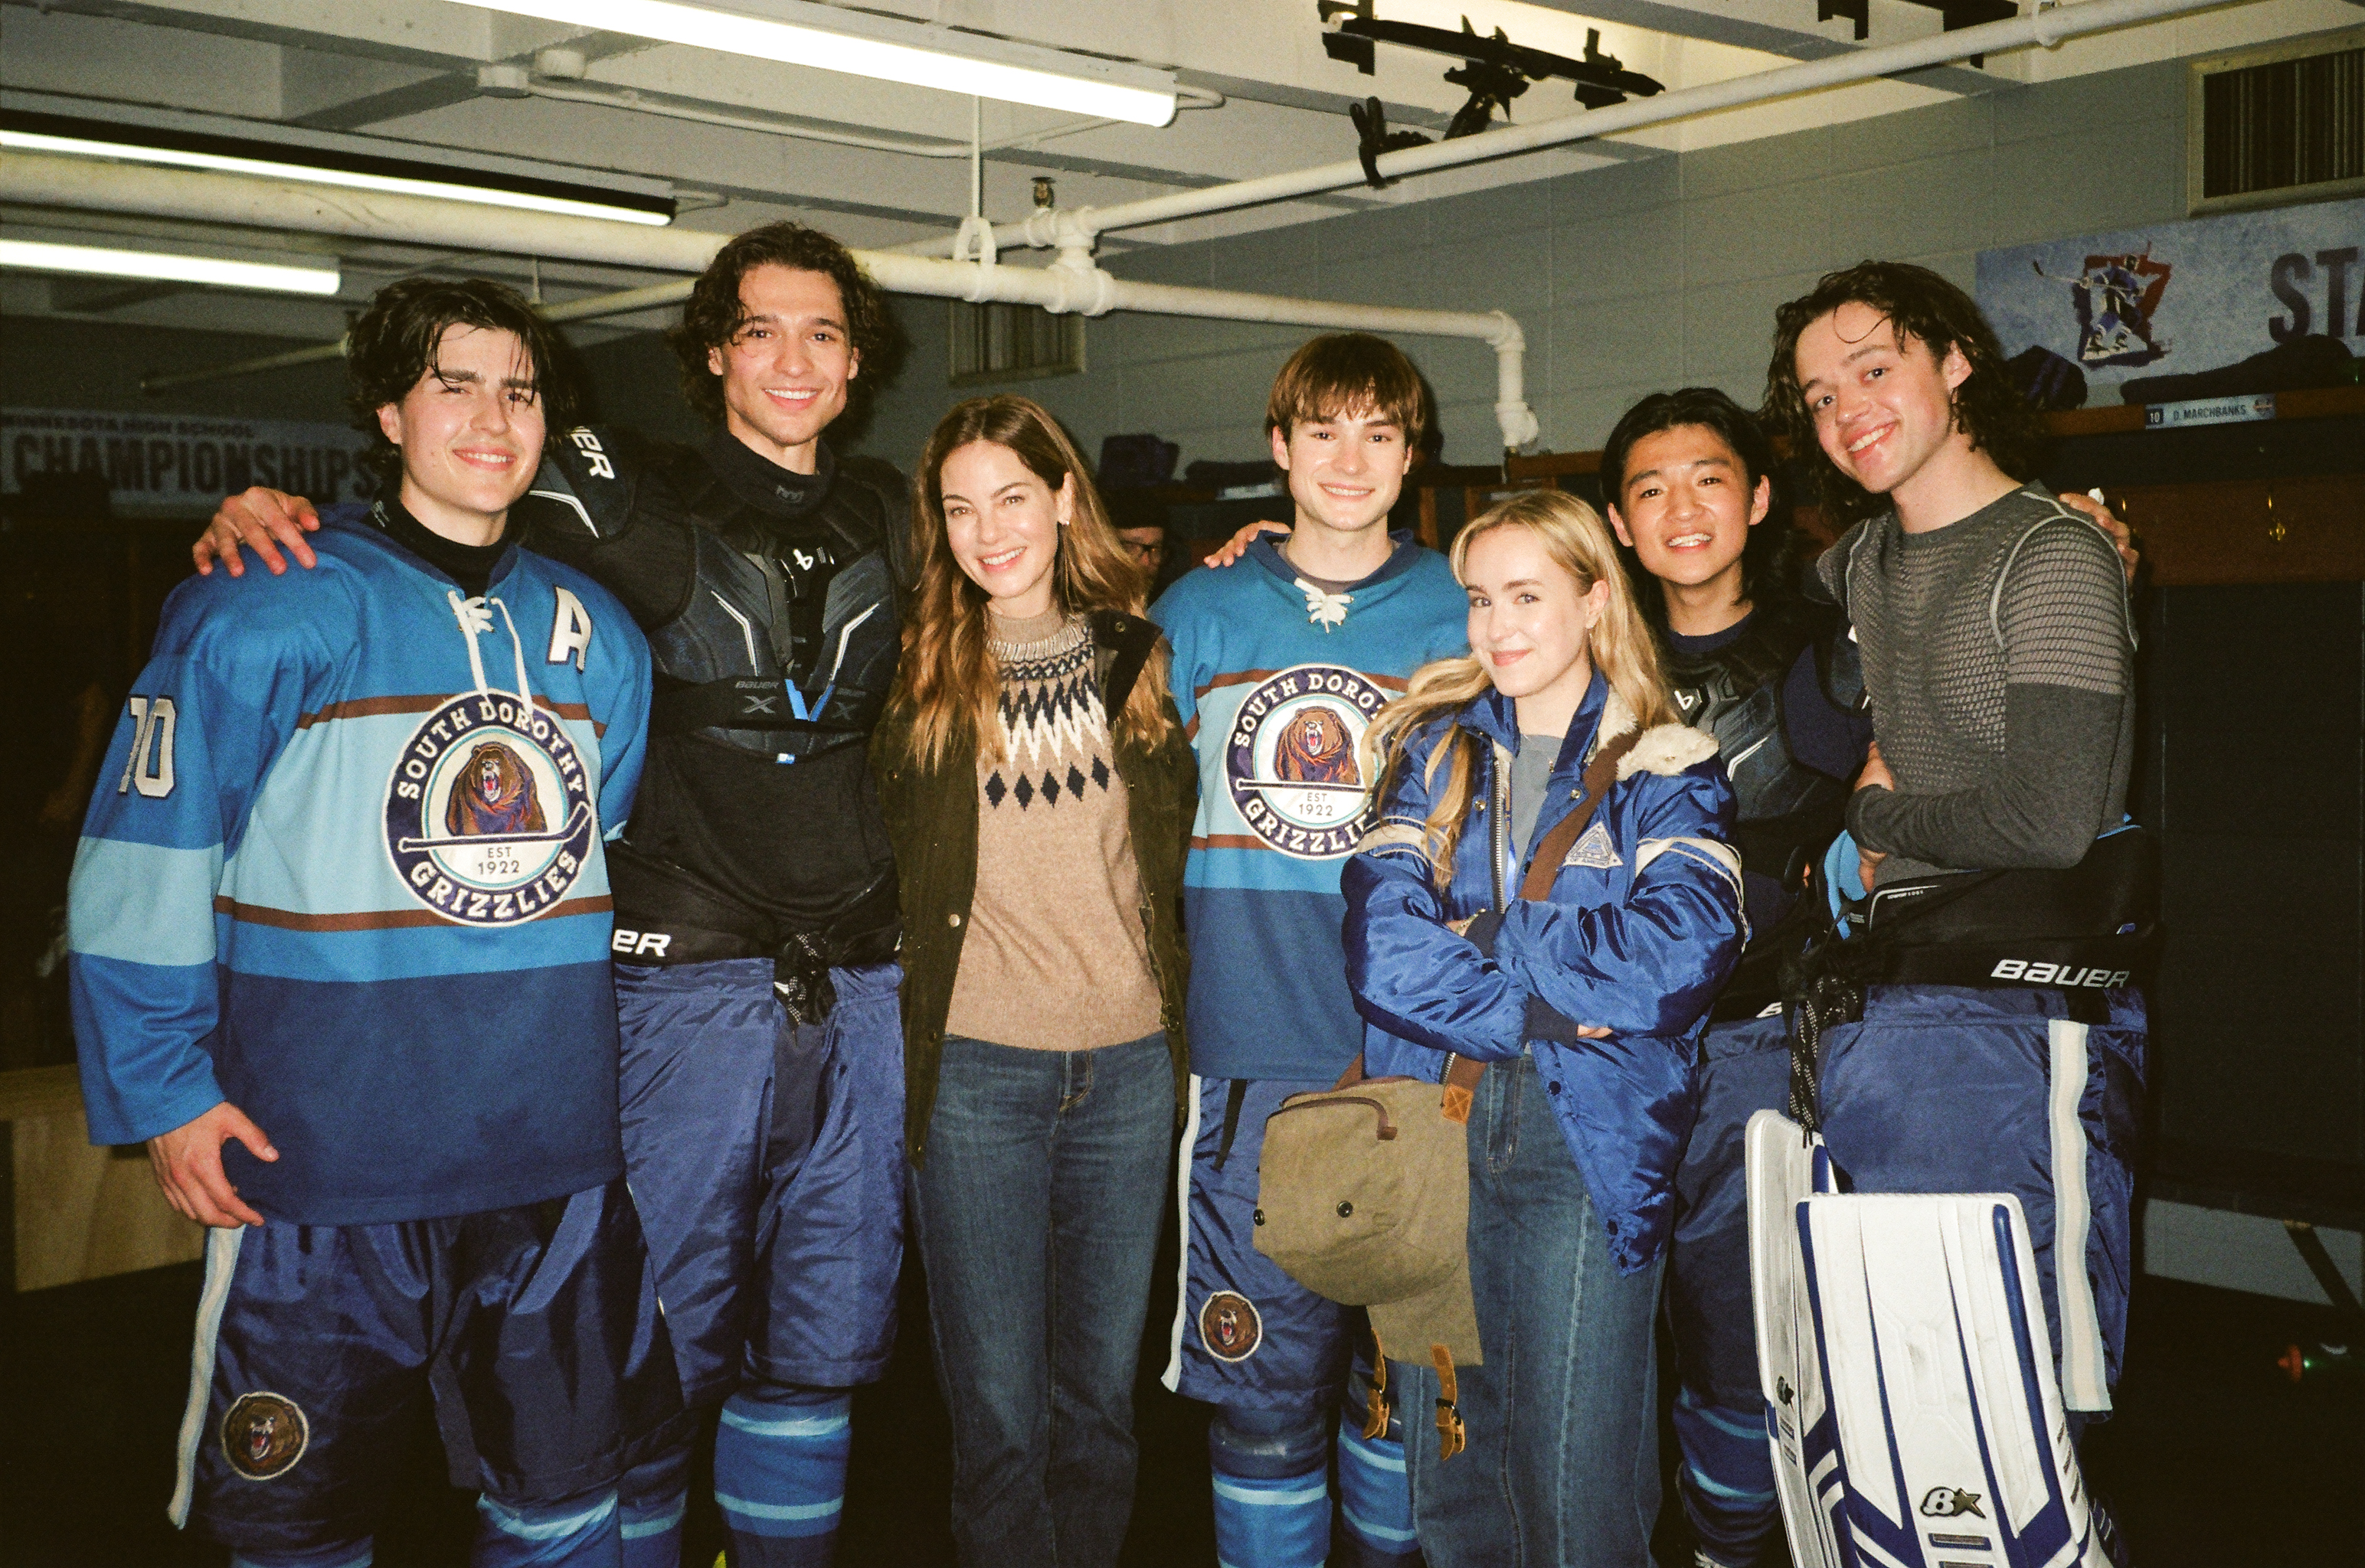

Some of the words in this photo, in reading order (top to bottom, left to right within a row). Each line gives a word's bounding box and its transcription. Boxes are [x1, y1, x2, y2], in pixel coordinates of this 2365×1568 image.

[121, 419, 172, 434] HIGH
[177, 422, 255, 439] SCHOOL
[2149, 411, 2161, 423] 10
[12, 433, 381, 499] CHAMPIONSHIPS
[571, 426, 615, 479] ER
[548, 586, 592, 671] A
[1234, 678, 1300, 748] SOUTH
[118, 697, 176, 797] 10
[397, 707, 472, 799] SOUTH
[479, 700, 584, 793] DOROTHY
[1299, 804, 1333, 817] 1922
[1307, 793, 1328, 802] EST
[478, 861, 519, 874] 1922
[487, 847, 512, 858] EST
[411, 850, 577, 919] GRIZZLIES
[1990, 959, 2131, 988] BAUER
